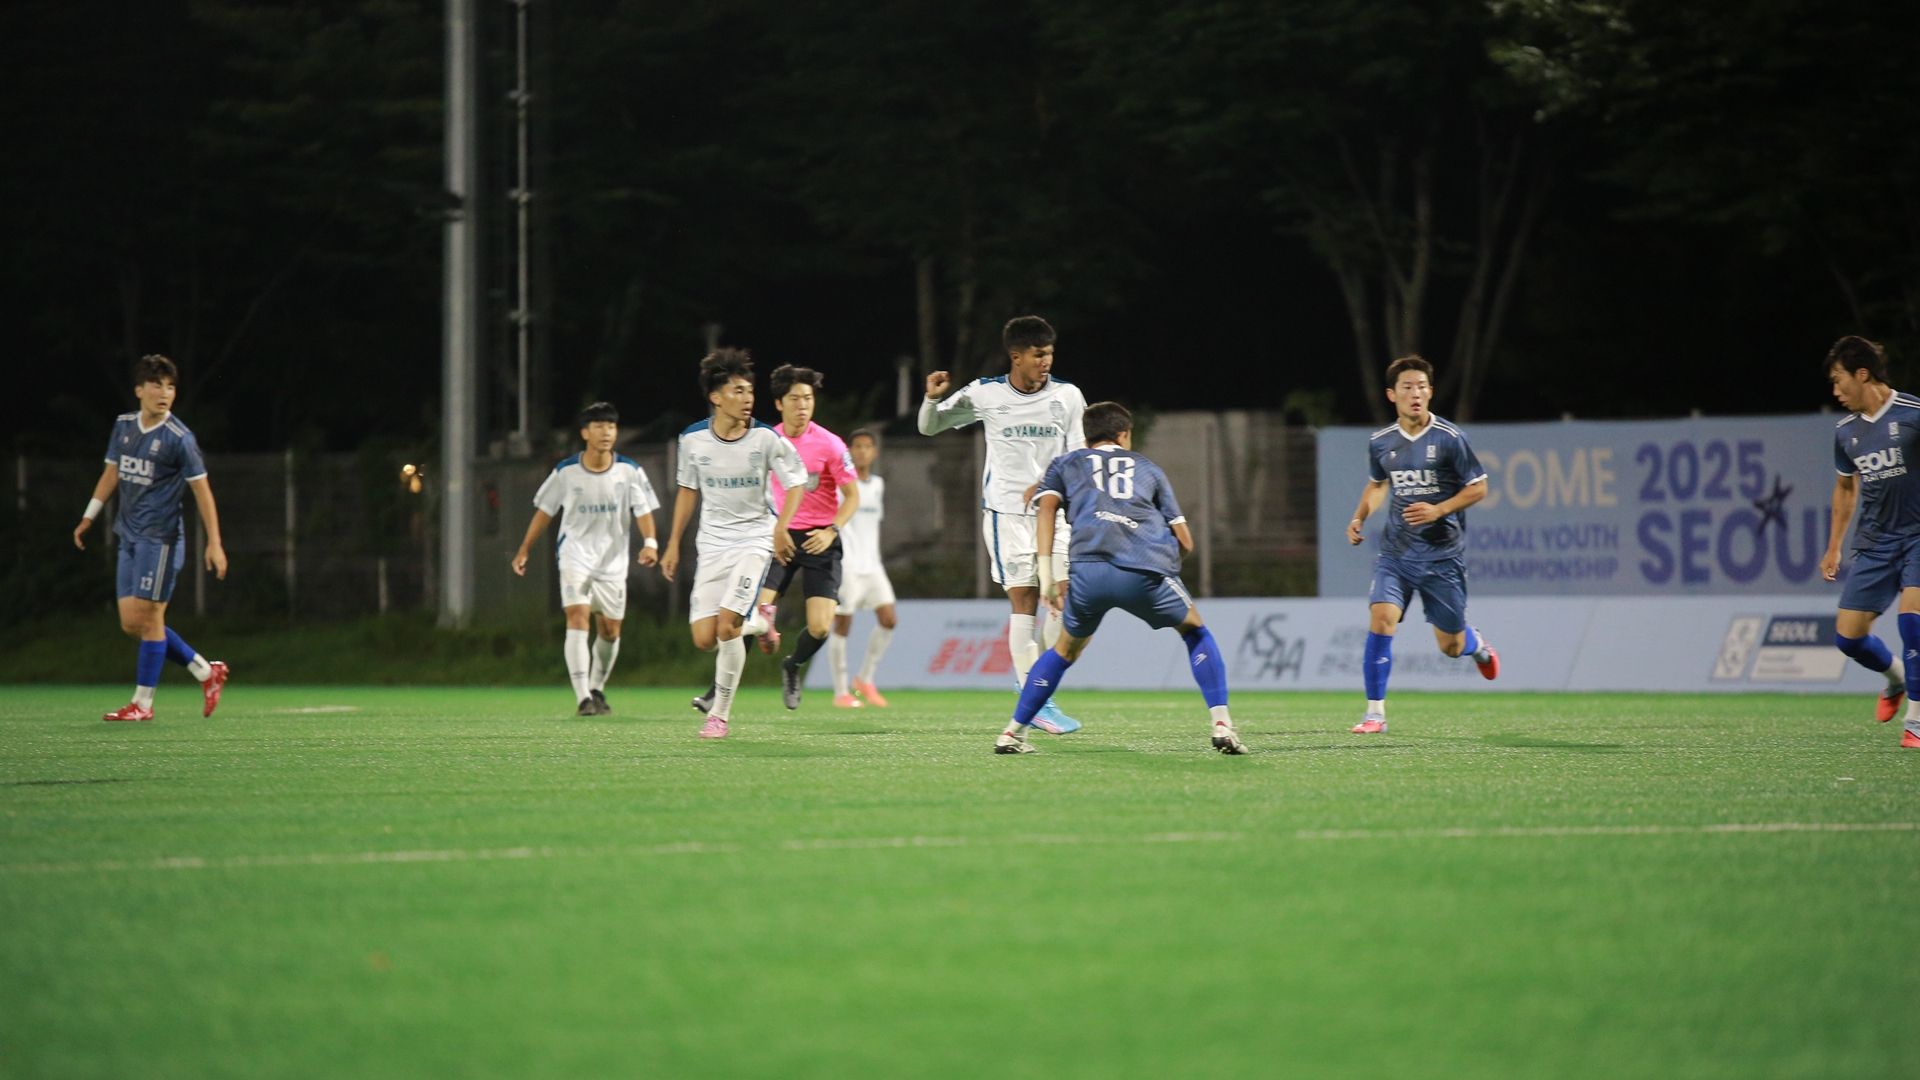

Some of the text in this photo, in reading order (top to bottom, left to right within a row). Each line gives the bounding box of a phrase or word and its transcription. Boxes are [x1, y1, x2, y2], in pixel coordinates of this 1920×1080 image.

[1014, 425, 1059, 438] YAMAHA
[1086, 454, 1135, 500] 18
[1475, 447, 1618, 509] COME
[1635, 440, 1766, 502] 2025
[718, 477, 761, 489] YAMAHA
[1542, 522, 1619, 549] YOUTH
[140, 576, 153, 590] 13
[738, 575, 752, 589] 10
